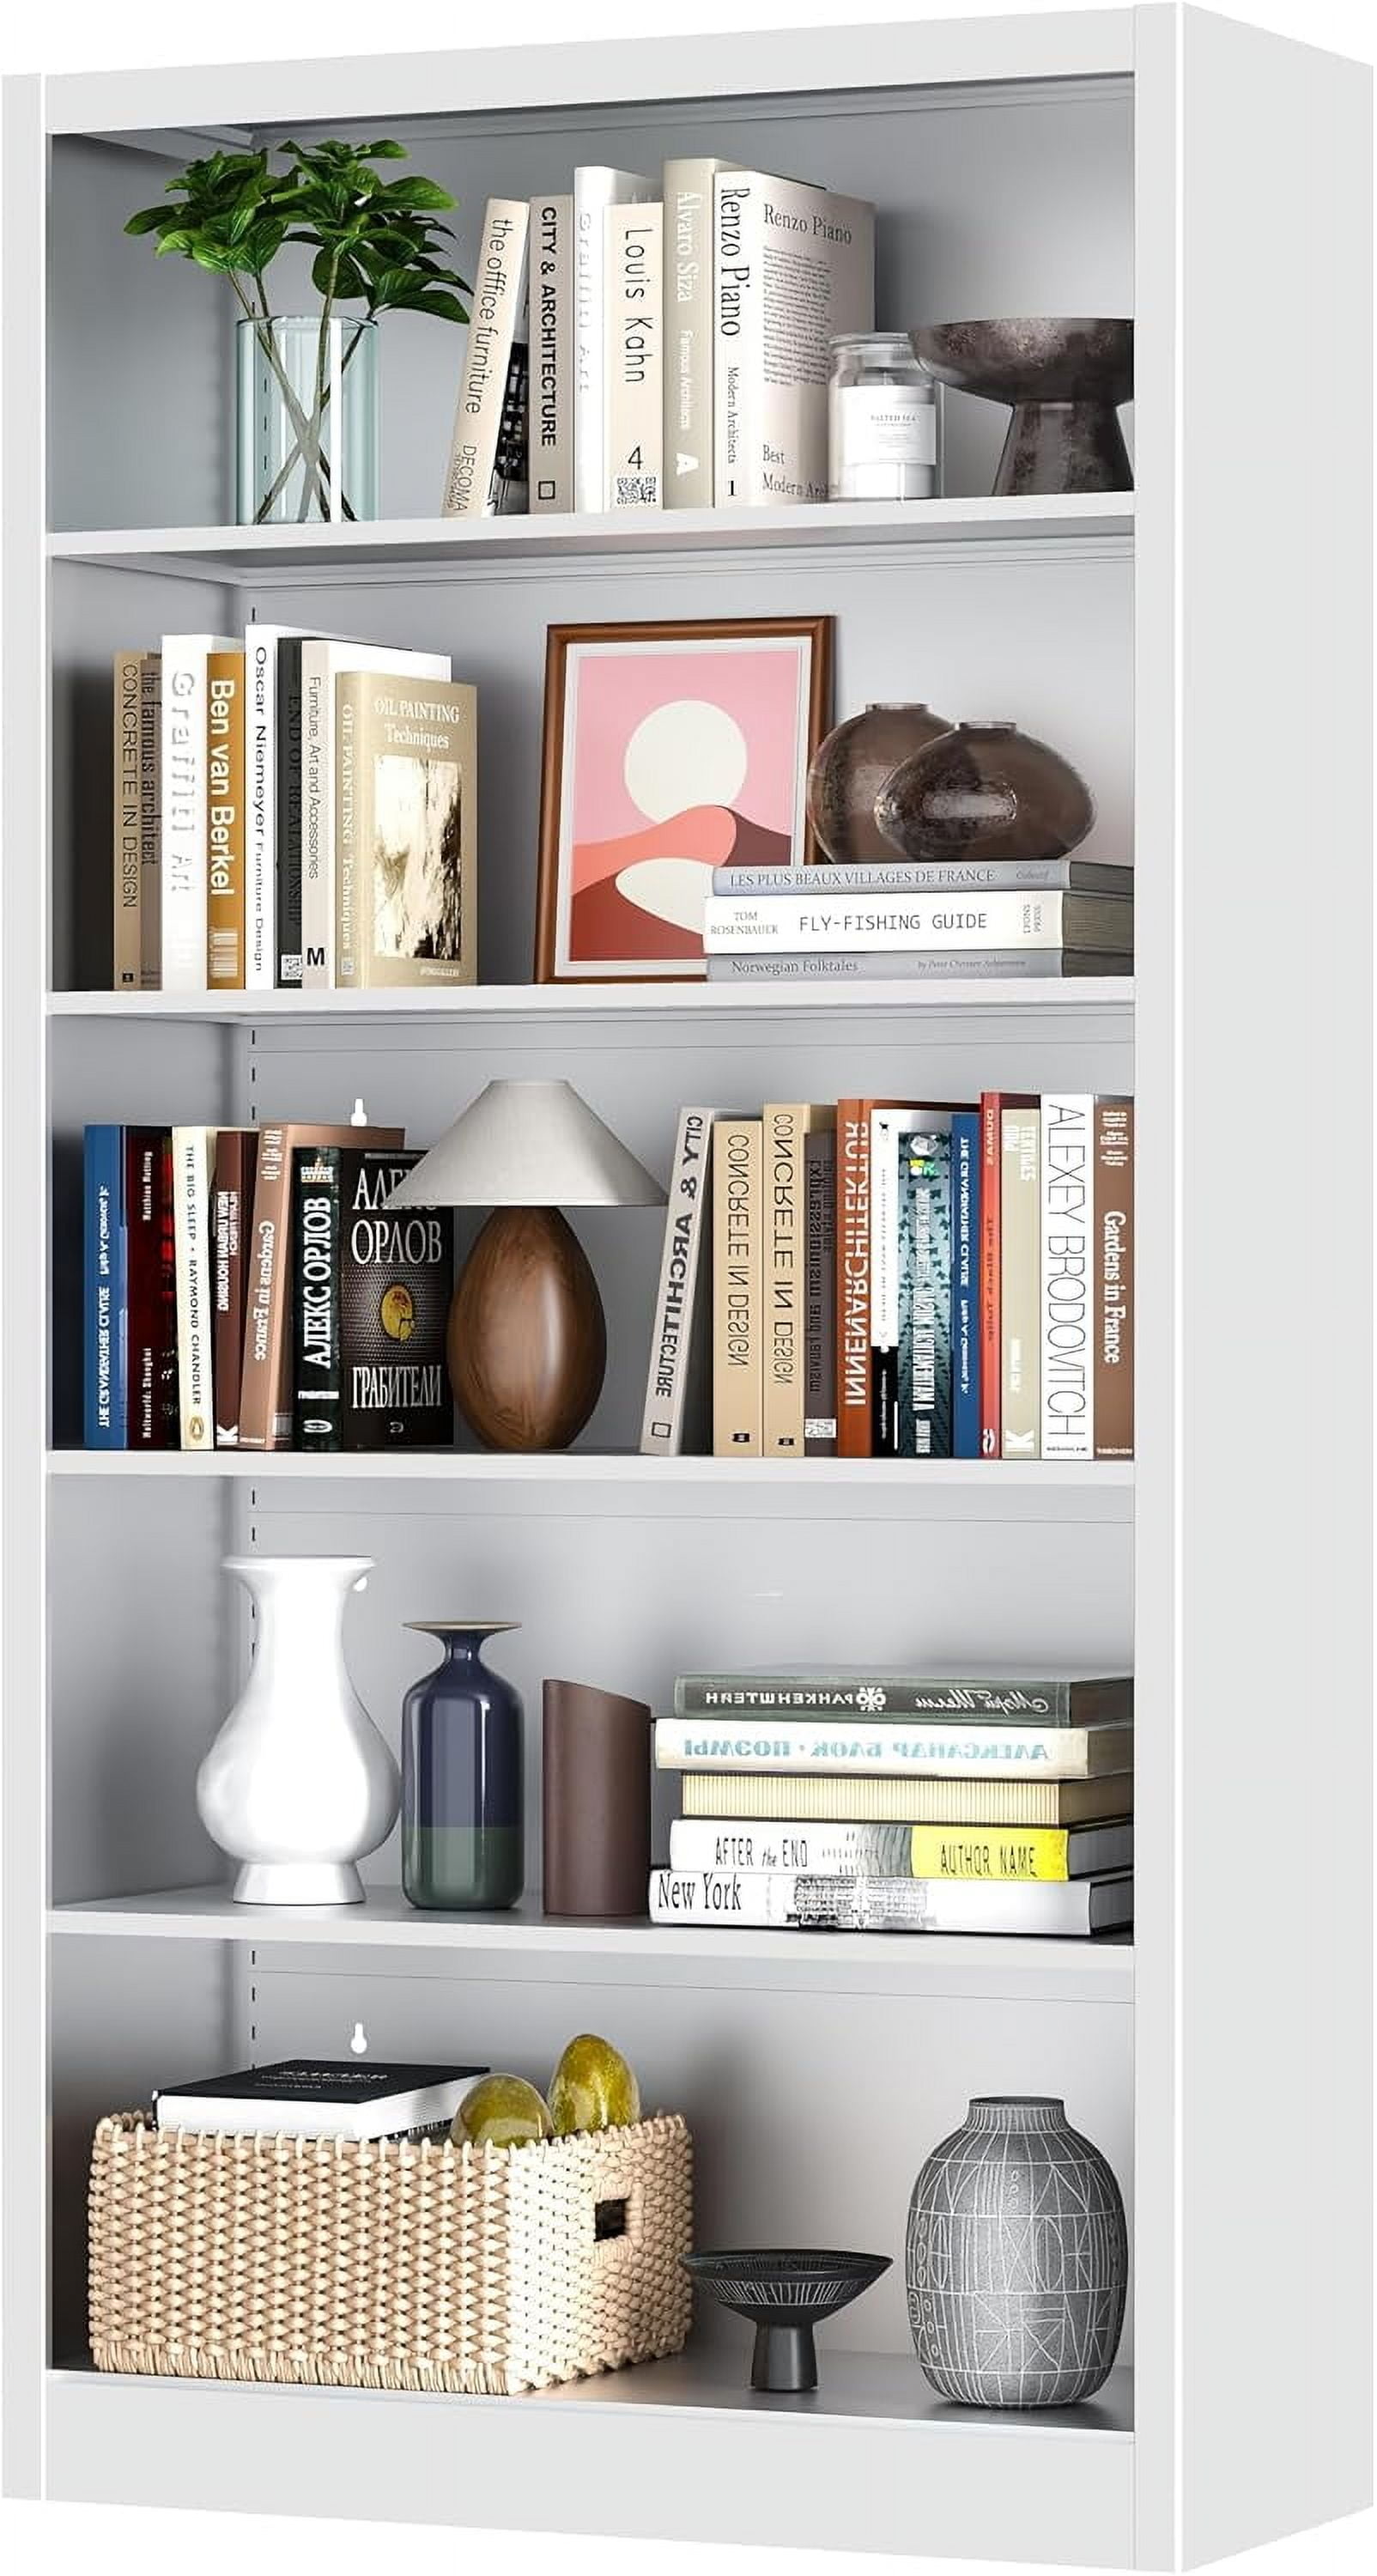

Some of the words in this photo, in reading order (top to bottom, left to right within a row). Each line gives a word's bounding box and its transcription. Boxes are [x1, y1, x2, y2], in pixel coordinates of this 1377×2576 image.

[489, 219, 513, 252] the
[541, 206, 557, 254] CITY
[720, 187, 750, 256] Renzo
[763, 203, 808, 234] Renzo
[811, 215, 852, 246] Piano
[540, 261, 558, 276] &
[625, 228, 654, 299] Louis
[676, 260, 701, 303] Siza
[720, 265, 750, 337] Piano
[466, 325, 499, 415] furniture
[541, 285, 557, 447] ARCHITECTURE
[625, 317, 653, 383] Kahn
[727, 366, 740, 408] Modern
[628, 447, 643, 471] 4
[675, 453, 700, 476] A
[762, 443, 785, 465] Best
[727, 479, 739, 497] 1
[762, 471, 803, 495] Modern
[142, 671, 161, 694] the
[254, 646, 267, 716] Oscar
[122, 664, 138, 795] CONCRETE
[210, 679, 234, 735] Ben
[306, 676, 322, 740] Furniture,
[373, 699, 397, 716] OIL
[399, 700, 460, 724] PAINTING
[142, 701, 162, 772] famous
[308, 744, 321, 764] Art
[385, 722, 450, 753] Techniques
[210, 744, 230, 796] van
[252, 725, 267, 837] Niemeyer
[308, 767, 321, 793] and
[122, 805, 138, 829] IN
[142, 780, 162, 866] architect
[308, 797, 321, 880] Accessories
[122, 837, 138, 908] DESIGN
[210, 805, 234, 896] Berkel
[254, 841, 264, 912] Furniture
[730, 872, 754, 887] LES
[757, 872, 791, 886] PLUS
[794, 872, 844, 885] BEAUX
[846, 870, 911, 884] VILLAGES
[915, 870, 934, 883] DE
[939, 869, 995, 883] FRANCE
[710, 925, 779, 935] ROSENBAUER
[733, 911, 758, 921] TOM
[799, 914, 921, 932] FLY-FISHING
[931, 913, 987, 930] GUIDE
[253, 917, 264, 972] Design
[306, 947, 325, 967] M
[731, 959, 798, 976] Norwegian
[803, 958, 858, 972] Folktales
[185, 1145, 194, 1169] THE
[1047, 1104, 1087, 1224] ALEXEY
[186, 1174, 196, 1198] BIG
[187, 1204, 197, 1241] SLEEP
[302, 1196, 331, 1282] ОРЛОВ
[351, 1219, 443, 1265] ОРЛОВ
[1104, 1210, 1127, 1281] Gardens
[188, 1259, 199, 1329] RAYMOND
[1105, 1284, 1127, 1302] in
[302, 1285, 331, 1369] АЛЕКС
[1046, 1235, 1087, 1437] BRODOVITCH
[1104, 1304, 1127, 1364] France
[191, 1334, 201, 1406] CHANDLER
[351, 1364, 442, 1409] ГРАБИТЕЛИ
[714, 1837, 754, 1867] AFTER
[761, 1846, 777, 1868] the
[782, 1838, 809, 1868] END
[940, 1844, 991, 1876] AUTHOR
[999, 1845, 1037, 1877] NAME
[658, 1873, 696, 1911] New
[702, 1872, 743, 1911] York
